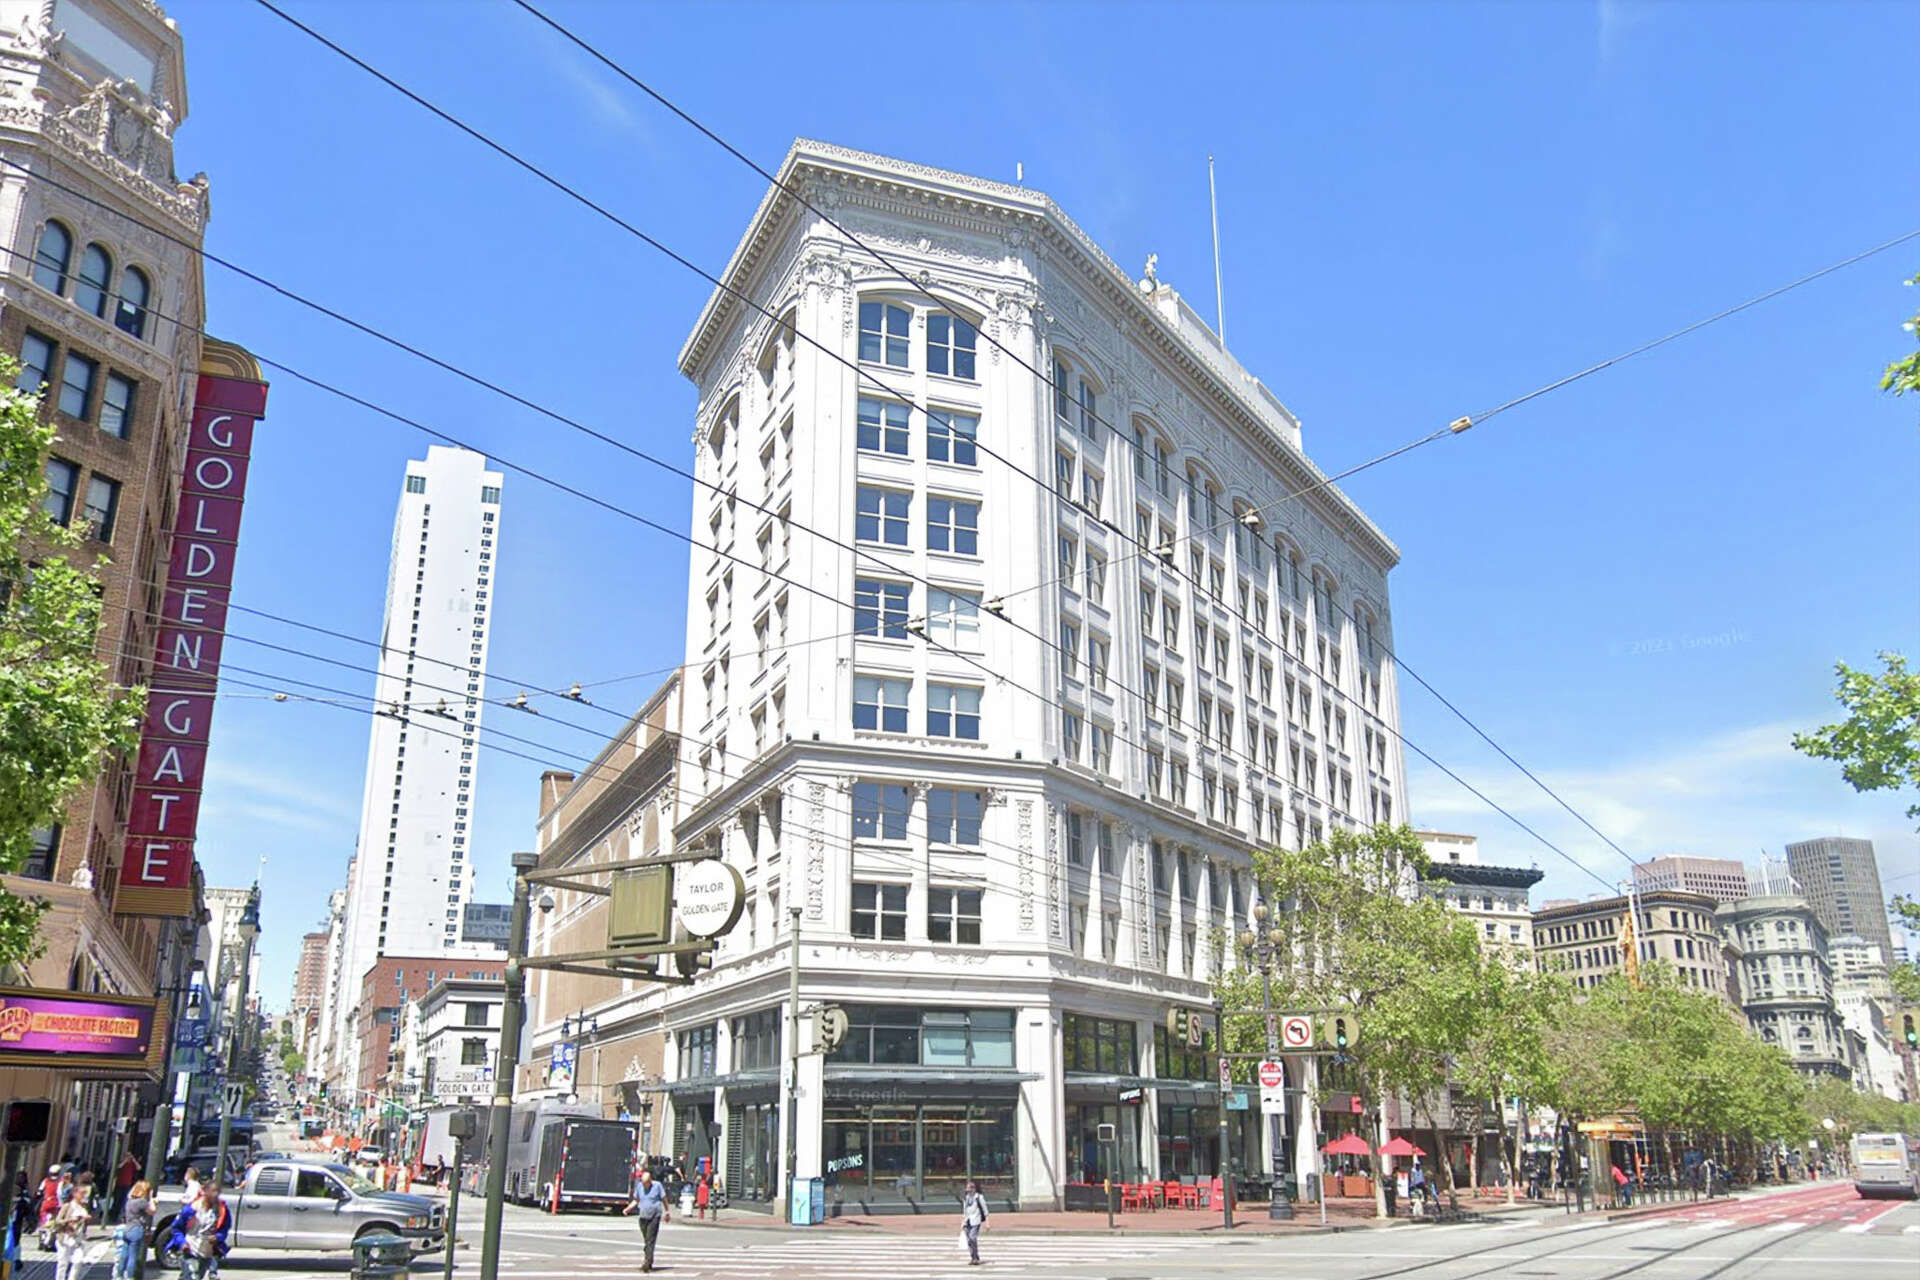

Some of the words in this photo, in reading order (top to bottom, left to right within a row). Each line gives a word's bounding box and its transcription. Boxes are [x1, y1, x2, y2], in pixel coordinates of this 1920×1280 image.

[172, 415, 233, 669] GOLDEN
[141, 700, 191, 882] GATE
[690, 881, 724, 895] TAYLOR
[682, 903, 710, 916] GOLDEN
[711, 901, 728, 913] GATE
[45, 1015, 97, 1032] CHOCOLATE
[99, 1018, 136, 1035] FACTORY
[438, 1084, 468, 1094] GOLDEN
[472, 1084, 490, 1094] GATE
[827, 1153, 864, 1174] POPSONS
